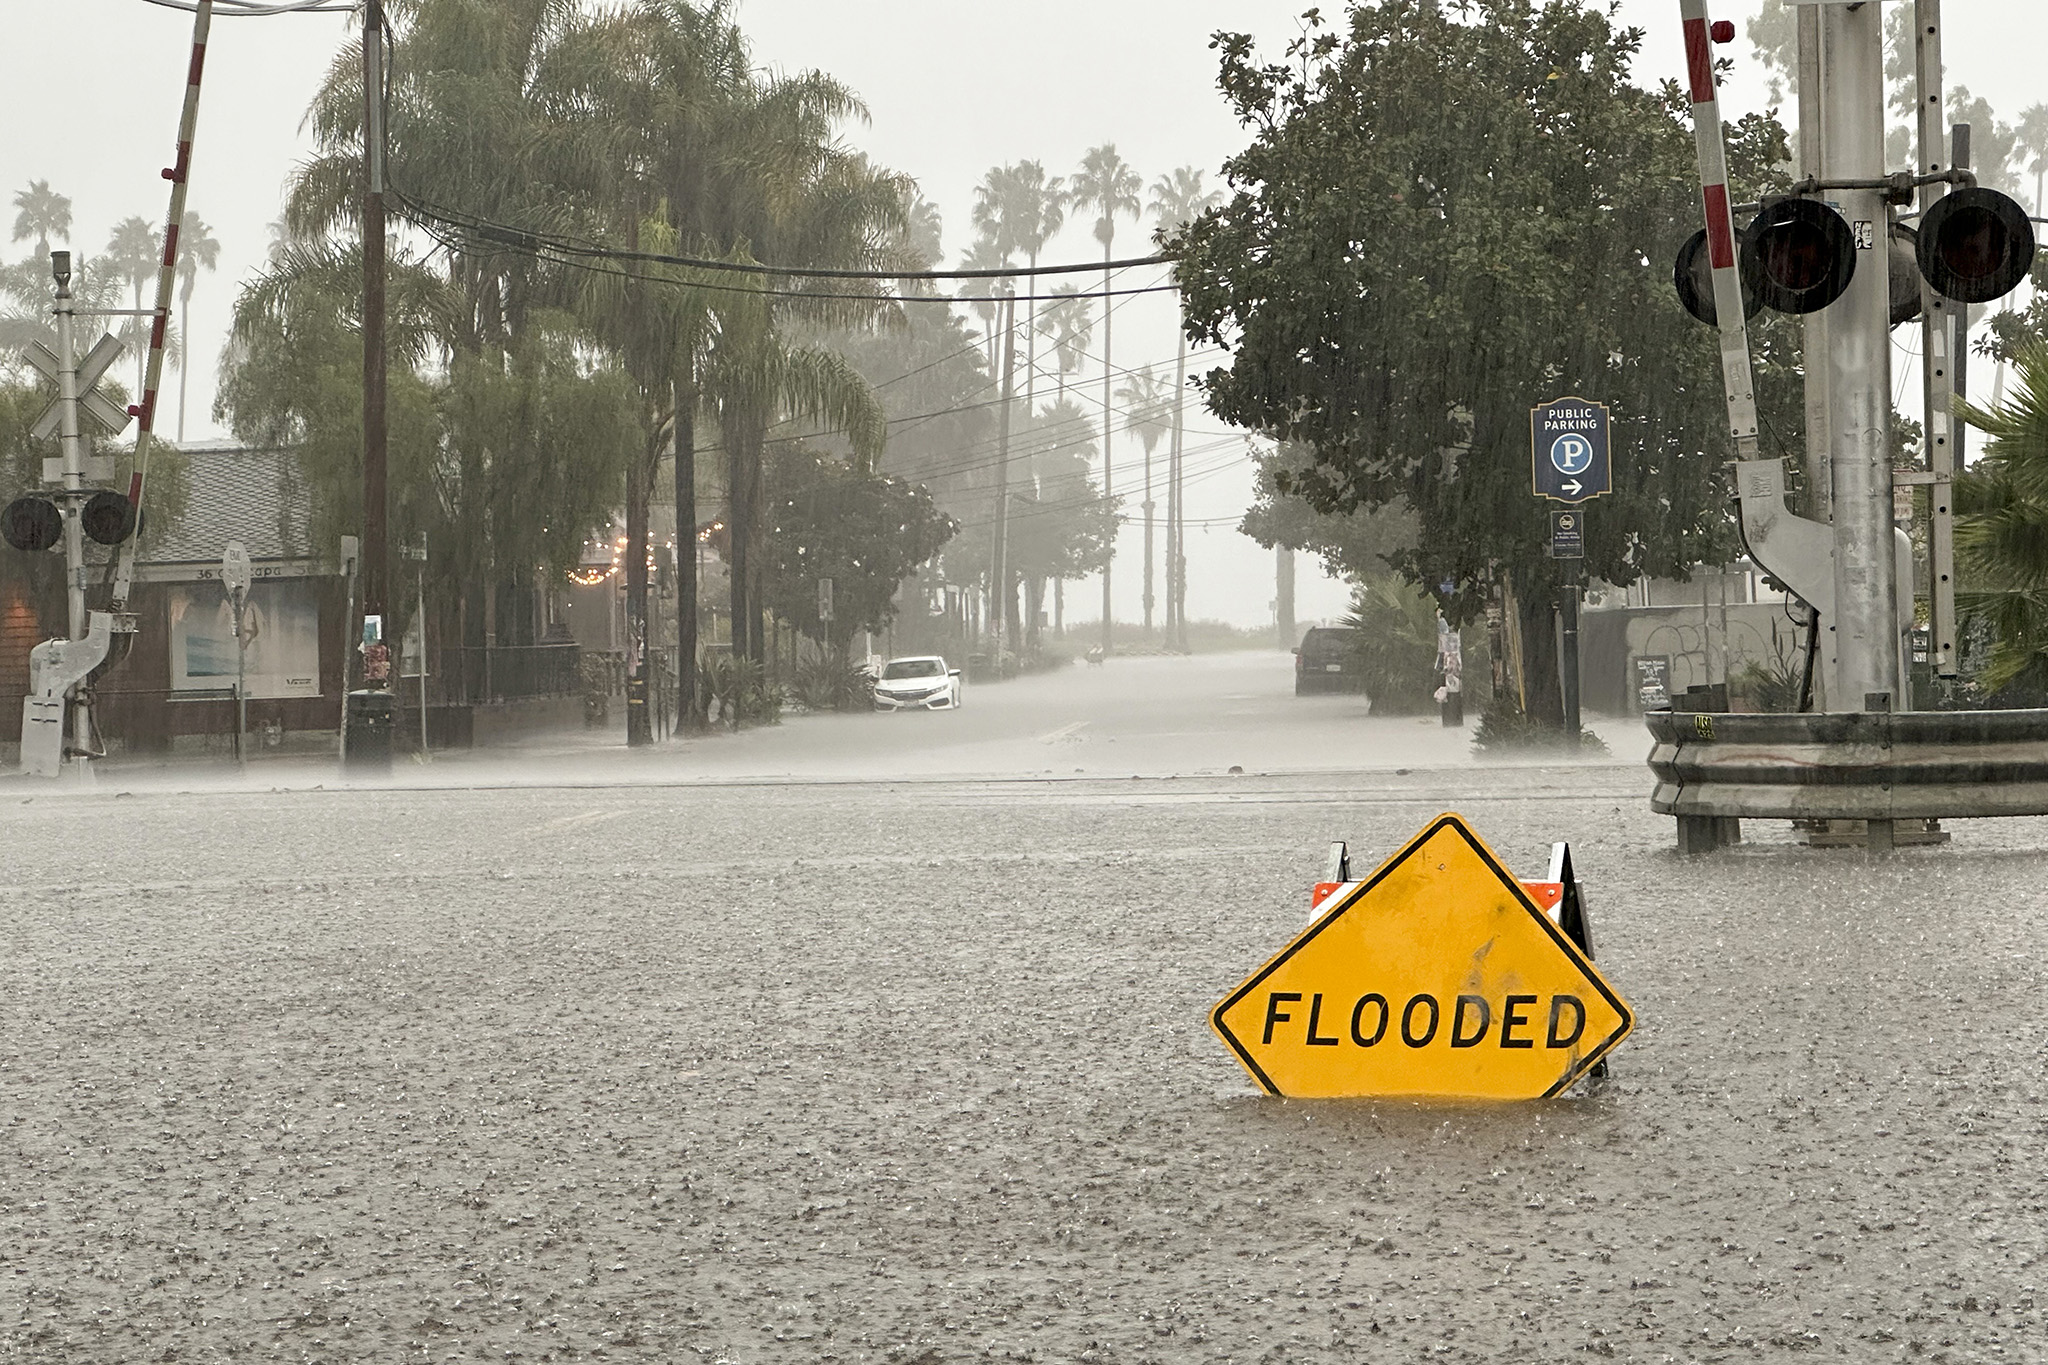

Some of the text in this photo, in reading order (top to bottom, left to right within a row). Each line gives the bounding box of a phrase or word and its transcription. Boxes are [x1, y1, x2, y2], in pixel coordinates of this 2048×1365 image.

[1549, 408, 1592, 420] PUBLIC
[1544, 419, 1597, 431] PARKING
[1562, 440, 1584, 468] P
[196, 568, 212, 579] 36
[1262, 993, 1587, 1049] FLOODED
